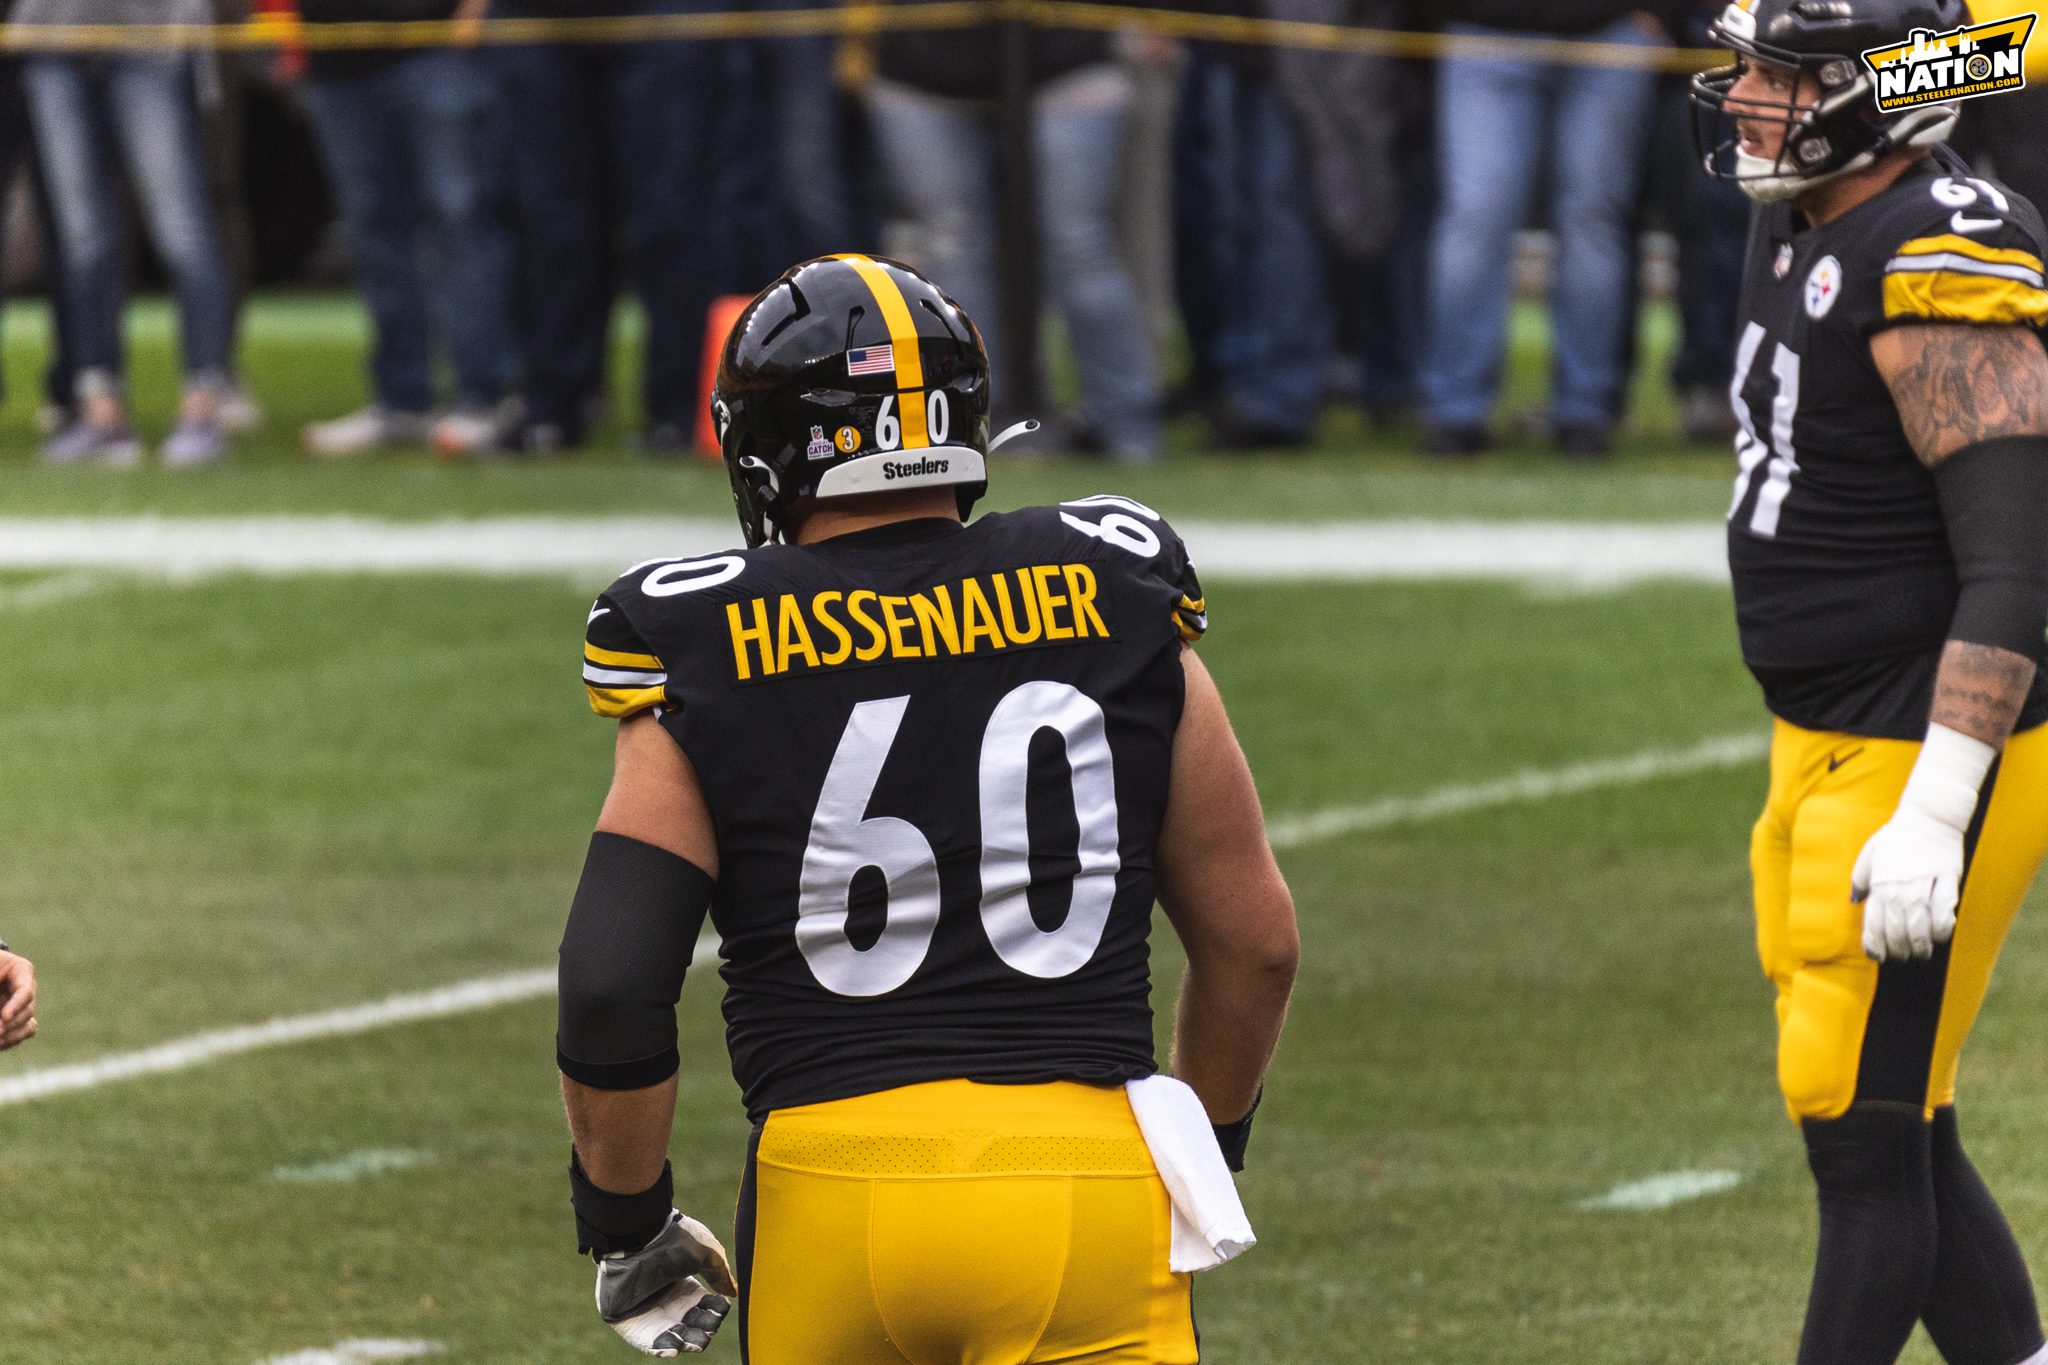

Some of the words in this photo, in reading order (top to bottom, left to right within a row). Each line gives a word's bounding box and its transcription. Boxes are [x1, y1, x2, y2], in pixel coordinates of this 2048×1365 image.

[808, 443, 833, 456] CATCH
[841, 426, 855, 451] 3
[882, 457, 949, 480] Steelers
[725, 562, 1111, 681] HASSENAUER
[794, 680, 1121, 997] 60
